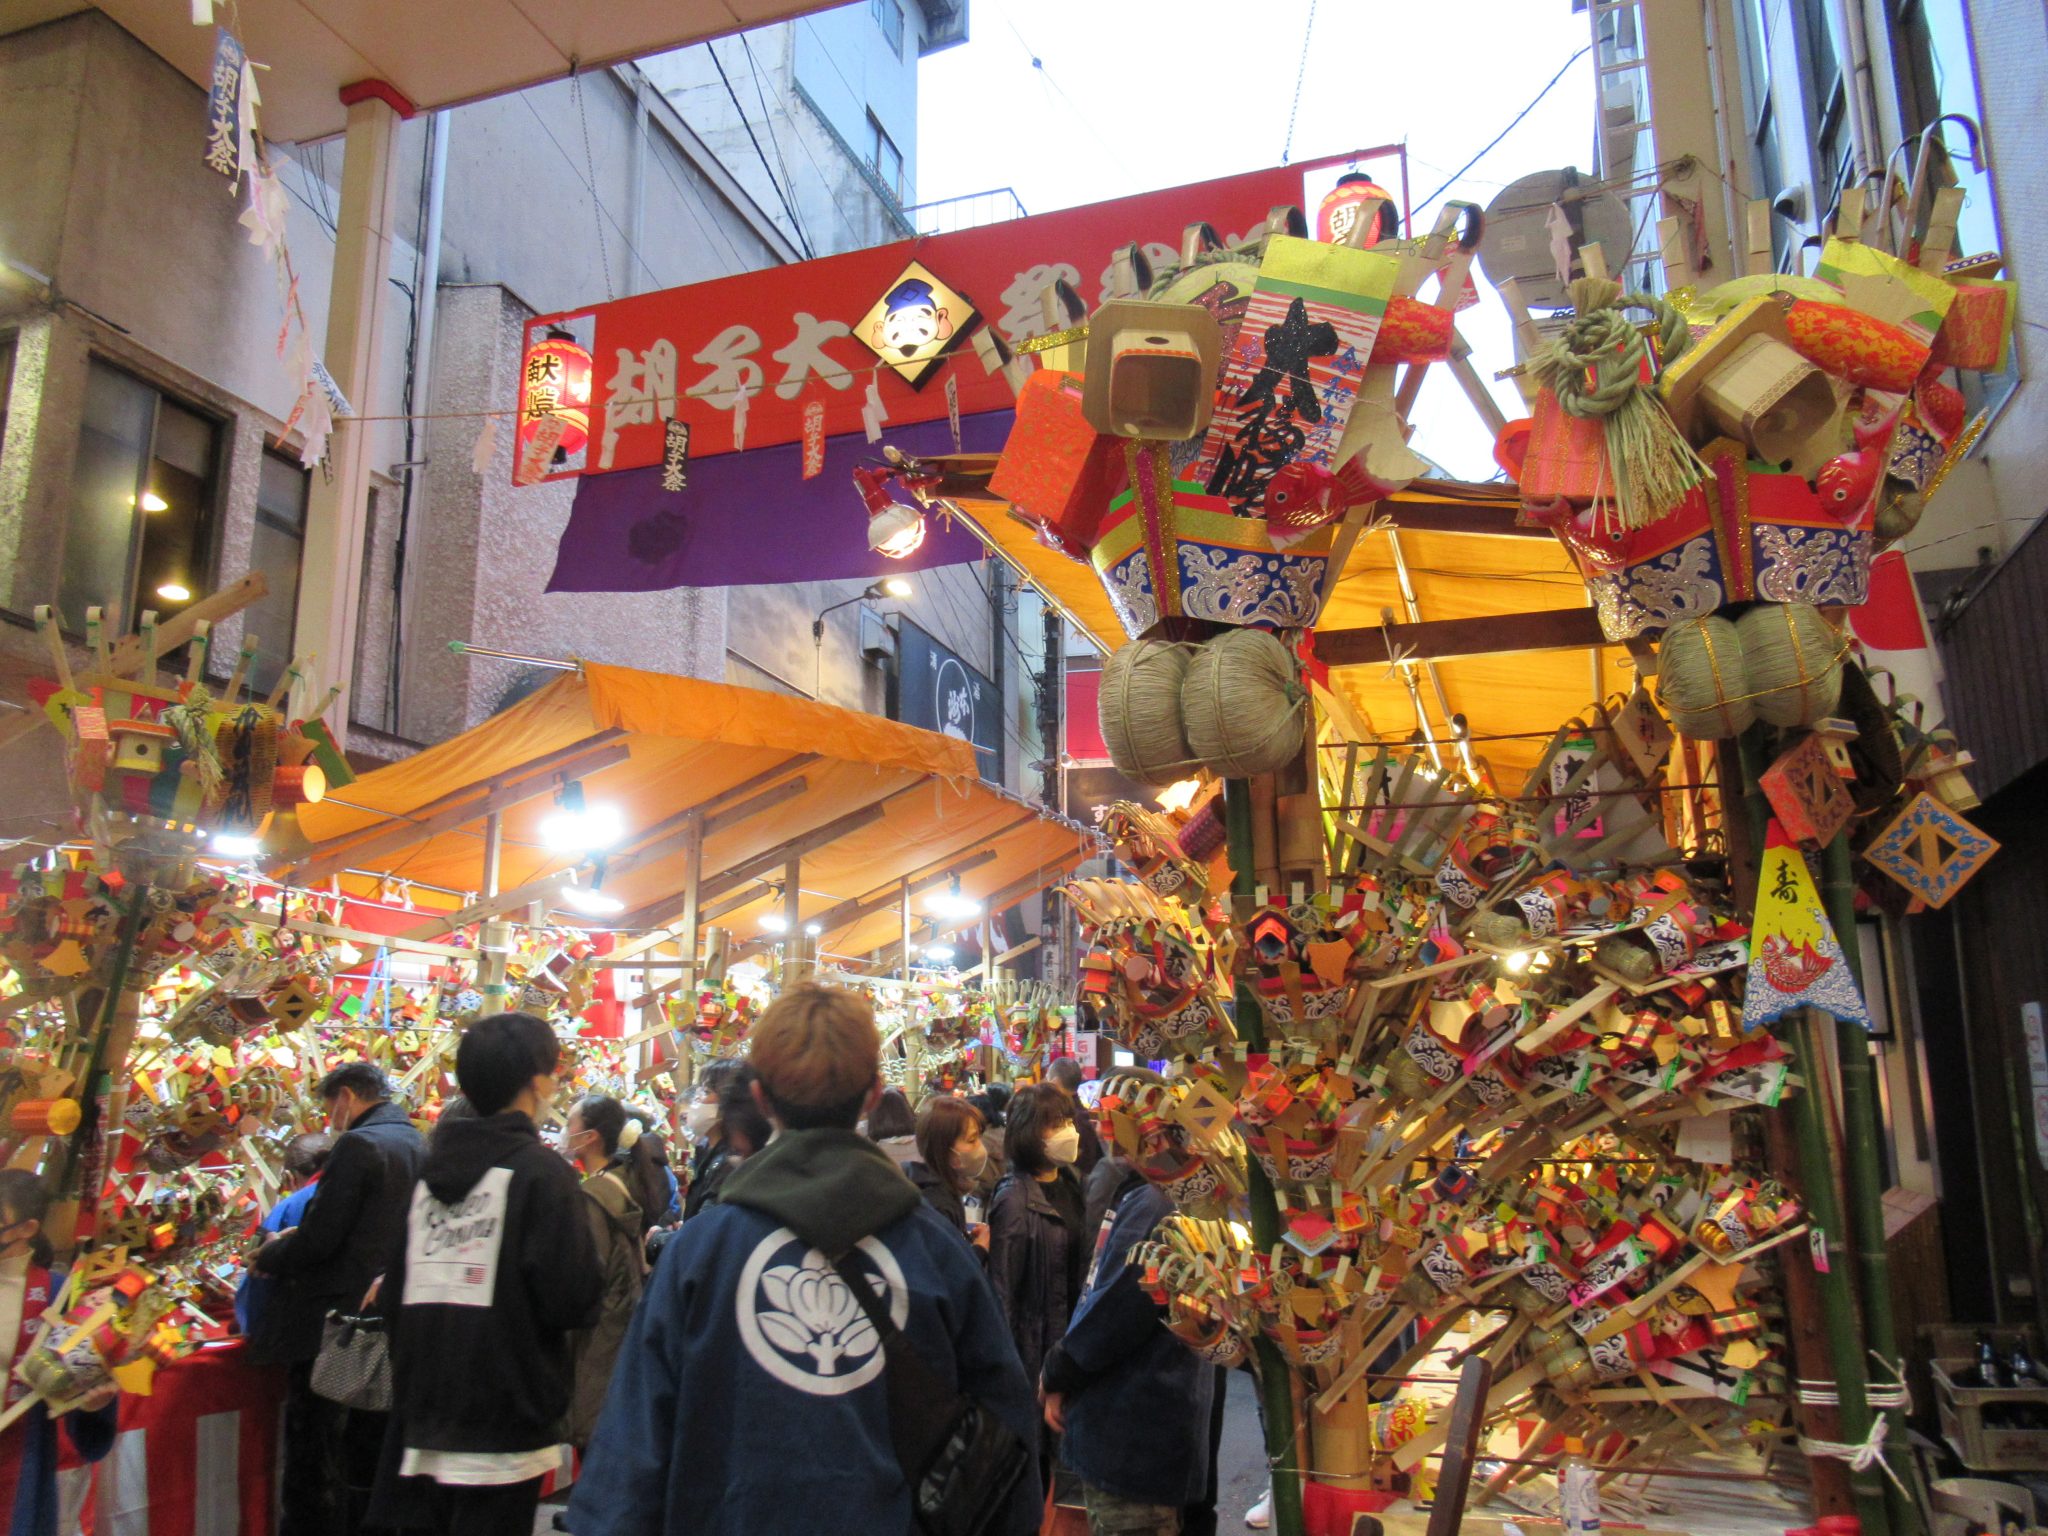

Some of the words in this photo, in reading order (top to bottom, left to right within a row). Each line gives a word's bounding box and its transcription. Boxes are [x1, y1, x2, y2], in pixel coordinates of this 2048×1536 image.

[661, 434, 688, 492] 胡子大祭
[1770, 859, 1799, 904] 寿
